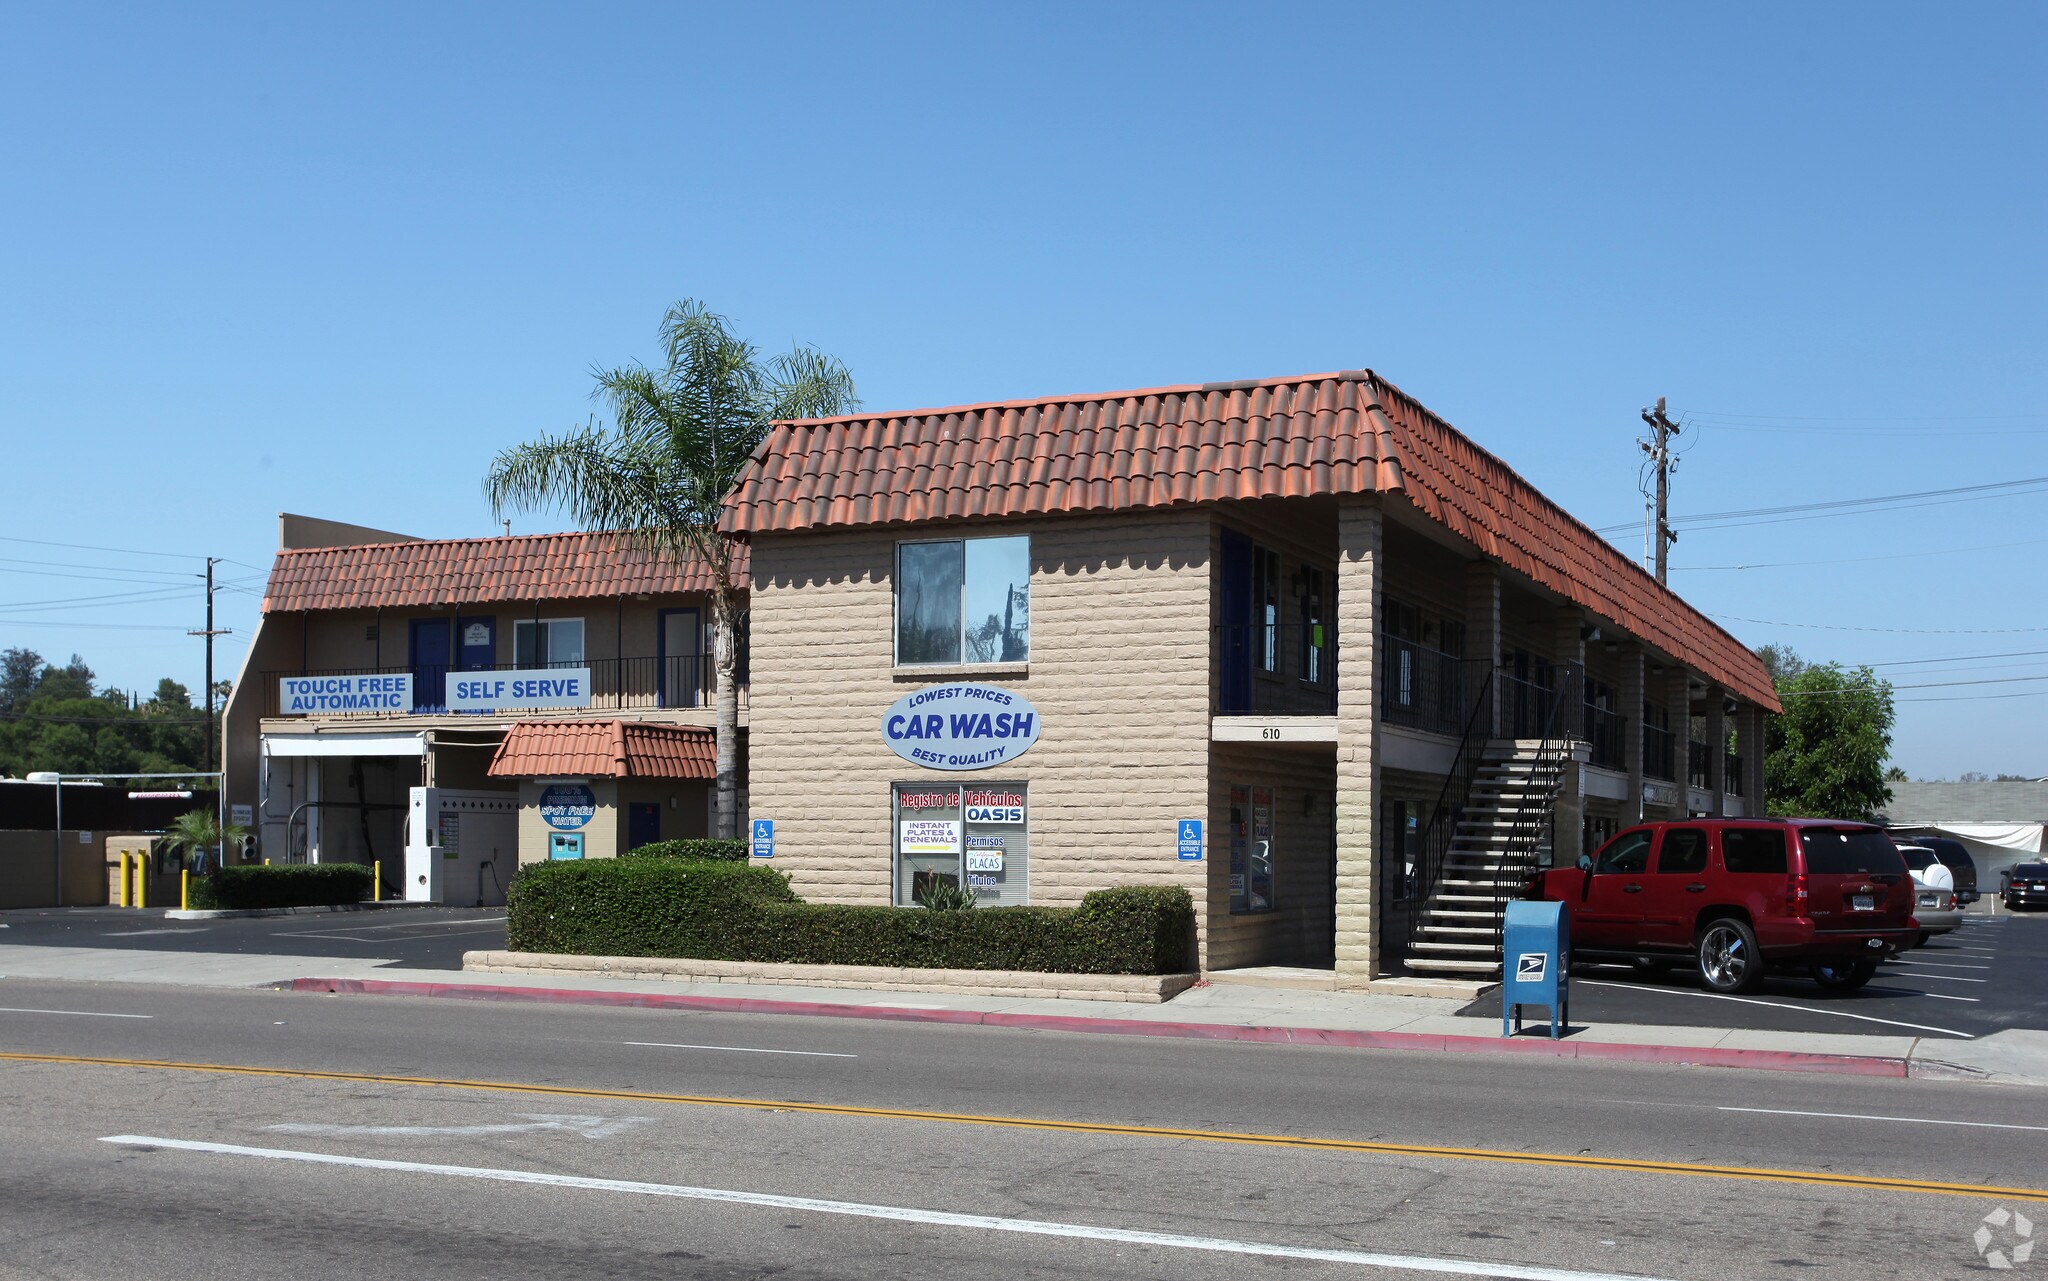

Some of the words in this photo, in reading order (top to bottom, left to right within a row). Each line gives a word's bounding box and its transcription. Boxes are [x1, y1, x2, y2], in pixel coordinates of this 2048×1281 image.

[286, 679, 350, 695] TOUCH
[358, 677, 406, 692] FREE
[456, 681, 505, 699] SELF
[512, 679, 579, 698] SERVE
[291, 693, 401, 710] AUTOMATIC
[909, 688, 962, 708] LOWEST
[965, 688, 1012, 706] PRICES
[887, 714, 944, 740] CAR
[950, 713, 1034, 739] WASH
[1262, 728, 1281, 740] 610
[911, 748, 946, 764] BEST
[948, 746, 1006, 765] QUALITY
[553, 785, 582, 795] 100%
[547, 795, 588, 805] PREMIUM
[901, 792, 943, 810] Registro
[947, 792, 959, 806] de
[965, 790, 1022, 807] Vehículos
[541, 806, 567, 815] SPOT
[567, 806, 594, 815] FREE
[967, 808, 1022, 821] OASIS
[551, 817, 582, 826] WATER
[966, 835, 1004, 847] Permisos
[969, 857, 1000, 869] PLACAS
